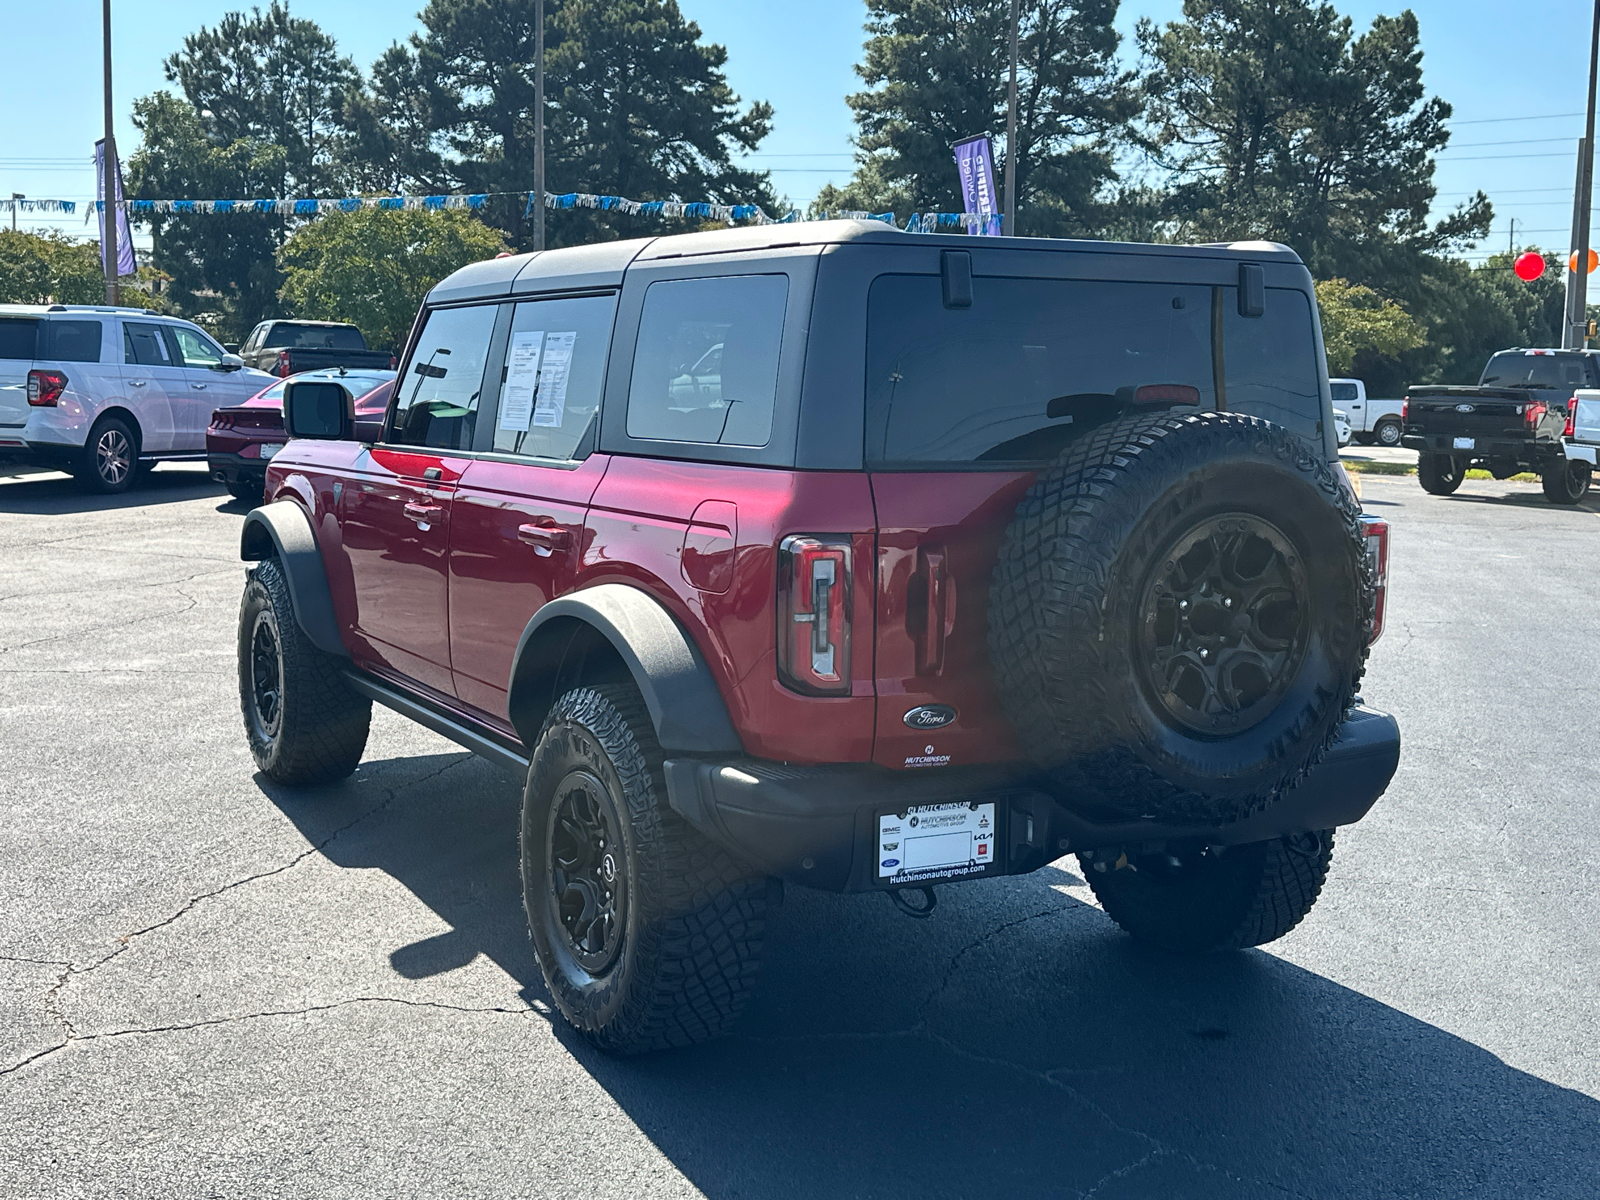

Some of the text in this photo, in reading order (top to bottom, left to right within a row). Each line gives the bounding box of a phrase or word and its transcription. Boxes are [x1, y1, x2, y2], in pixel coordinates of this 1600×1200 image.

[917, 710, 946, 724] Ford
[905, 755, 950, 764] HUTCHINSON
[921, 813, 967, 824] HUTCHINSON
[921, 820, 966, 830] AUTOMOTIVE GROUP
[974, 833, 993, 841] KIA
[890, 865, 985, 884] Hutchinsonautogroup.com
